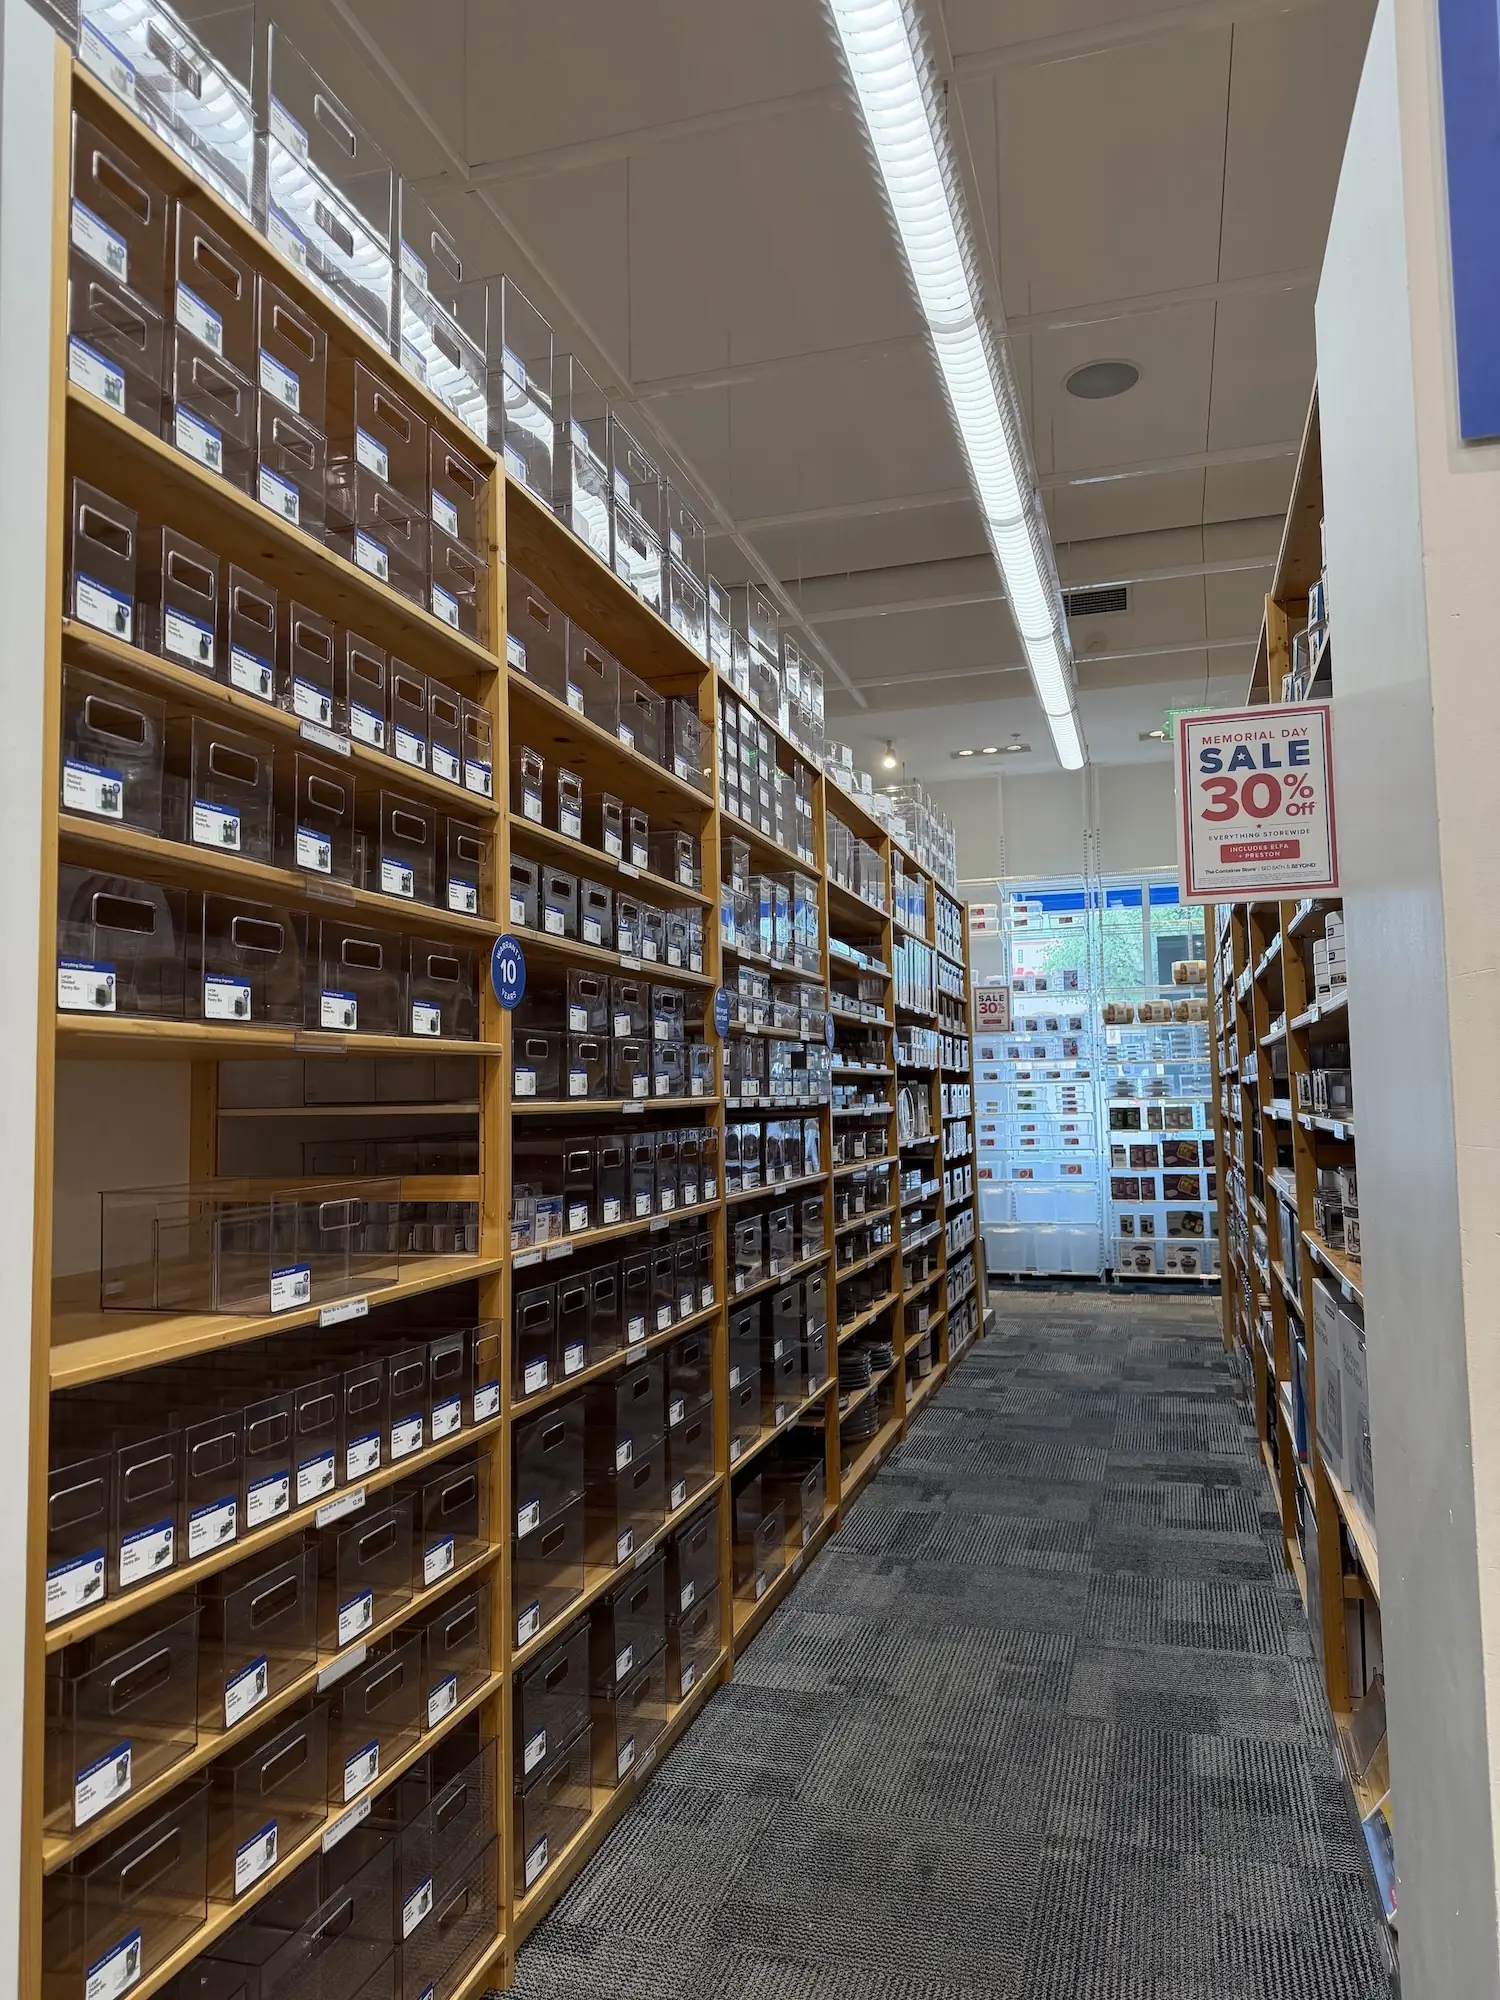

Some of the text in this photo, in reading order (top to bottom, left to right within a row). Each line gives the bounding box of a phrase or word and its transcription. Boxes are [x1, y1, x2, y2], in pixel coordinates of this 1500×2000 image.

[1202, 727, 1308, 745] MEMORIAL DAY
[1199, 739, 1310, 774] SALE
[1200, 772, 1314, 822] 30%
[1208, 829, 1310, 841] EVERYTHING STOREWIDE
[496, 940, 521, 960] WARRANTY
[500, 958, 517, 984] 10
[502, 988, 516, 1000] YEARS
[978, 994, 1004, 1002] SALE
